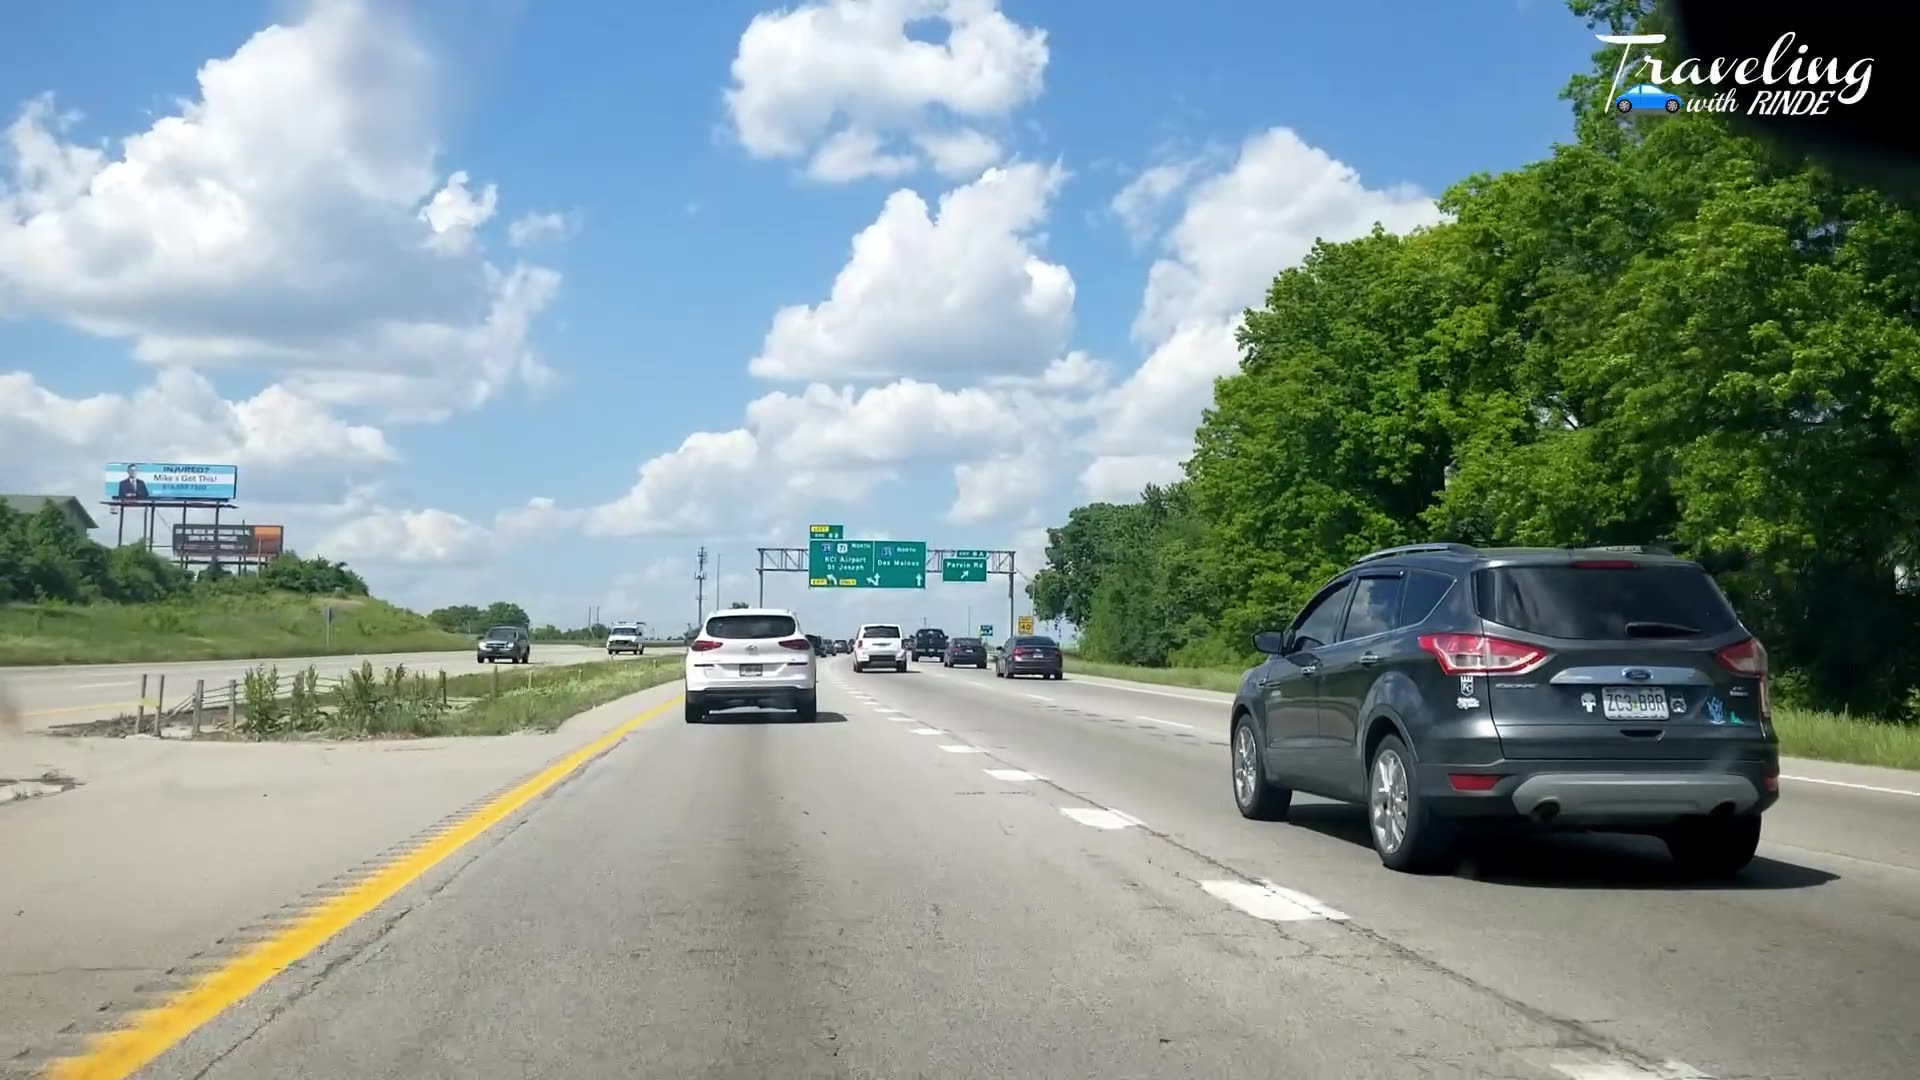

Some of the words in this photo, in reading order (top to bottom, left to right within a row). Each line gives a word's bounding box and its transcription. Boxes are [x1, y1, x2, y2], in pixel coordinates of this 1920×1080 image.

[181, 474, 197, 482] Got
[839, 556, 867, 564] Airport
[838, 564, 865, 572] Joseph
[946, 561, 971, 569] Parvin
[973, 561, 984, 569] Rd
[1020, 623, 1032, 631] 40
[1605, 693, 1632, 711] ZC3
